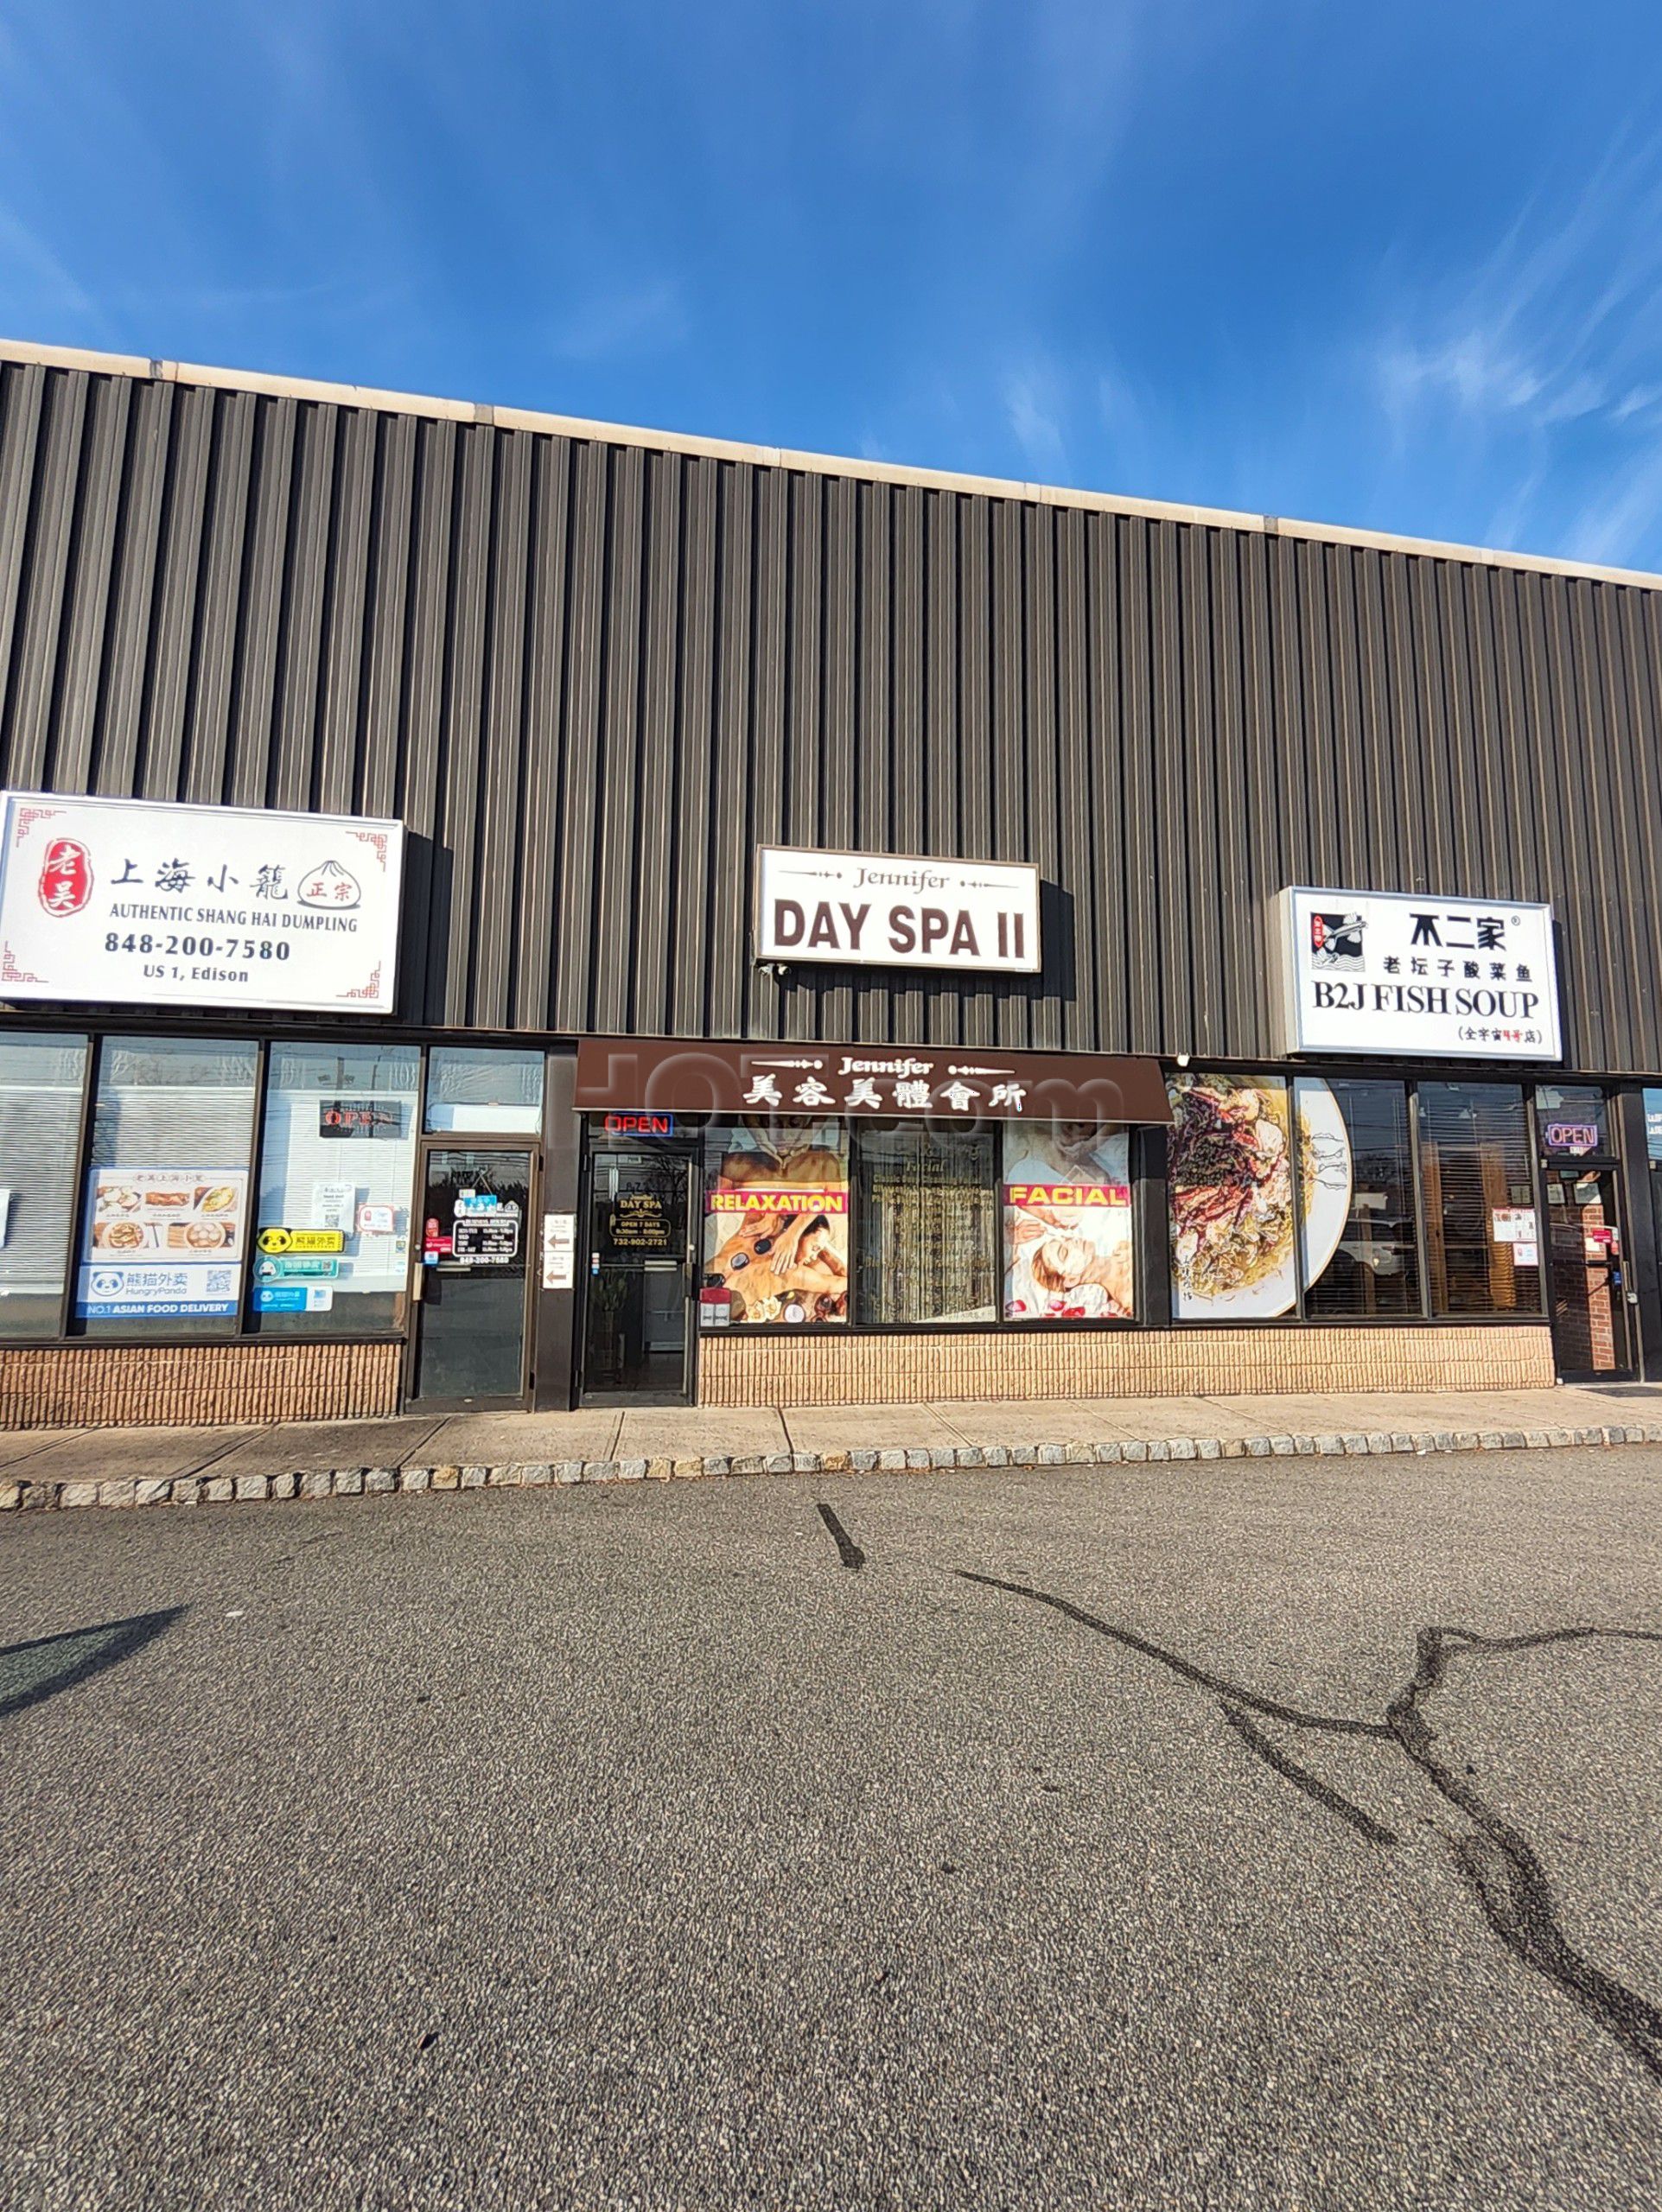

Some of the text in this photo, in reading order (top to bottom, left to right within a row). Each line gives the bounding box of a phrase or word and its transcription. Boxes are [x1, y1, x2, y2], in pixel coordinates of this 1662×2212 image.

[111, 858, 288, 899] 上海小籠
[853, 868, 950, 894] Jennifer
[307, 881, 352, 900] 正宗
[110, 903, 358, 933] AUTHENTIC SHANG HAI DUMPLING
[774, 899, 1025, 959] DAY SPA II
[1410, 912, 1506, 951] 不二家
[105, 932, 290, 961] 848-200-7580
[143, 965, 248, 982] US 1, Edison
[1384, 956, 1532, 982] 老坛子酸菜鱼
[1312, 981, 1538, 1019] B2J FISH SOUP
[837, 1056, 934, 1079] Jennifer
[742, 1073, 1027, 1112] 美容美體會所
[605, 1115, 668, 1134] OPEN
[1551, 1127, 1595, 1144] OPEN
[620, 1199, 662, 1210] DAY SPA
[710, 1194, 843, 1212] RELAXATION
[1009, 1186, 1127, 1206] FACIAL
[126, 1272, 188, 1287] 熊猫外卖
[125, 1287, 188, 1296] HungryPanda
[87, 1303, 228, 1314] NO.1 ASIAN FOOD DELIVERY
